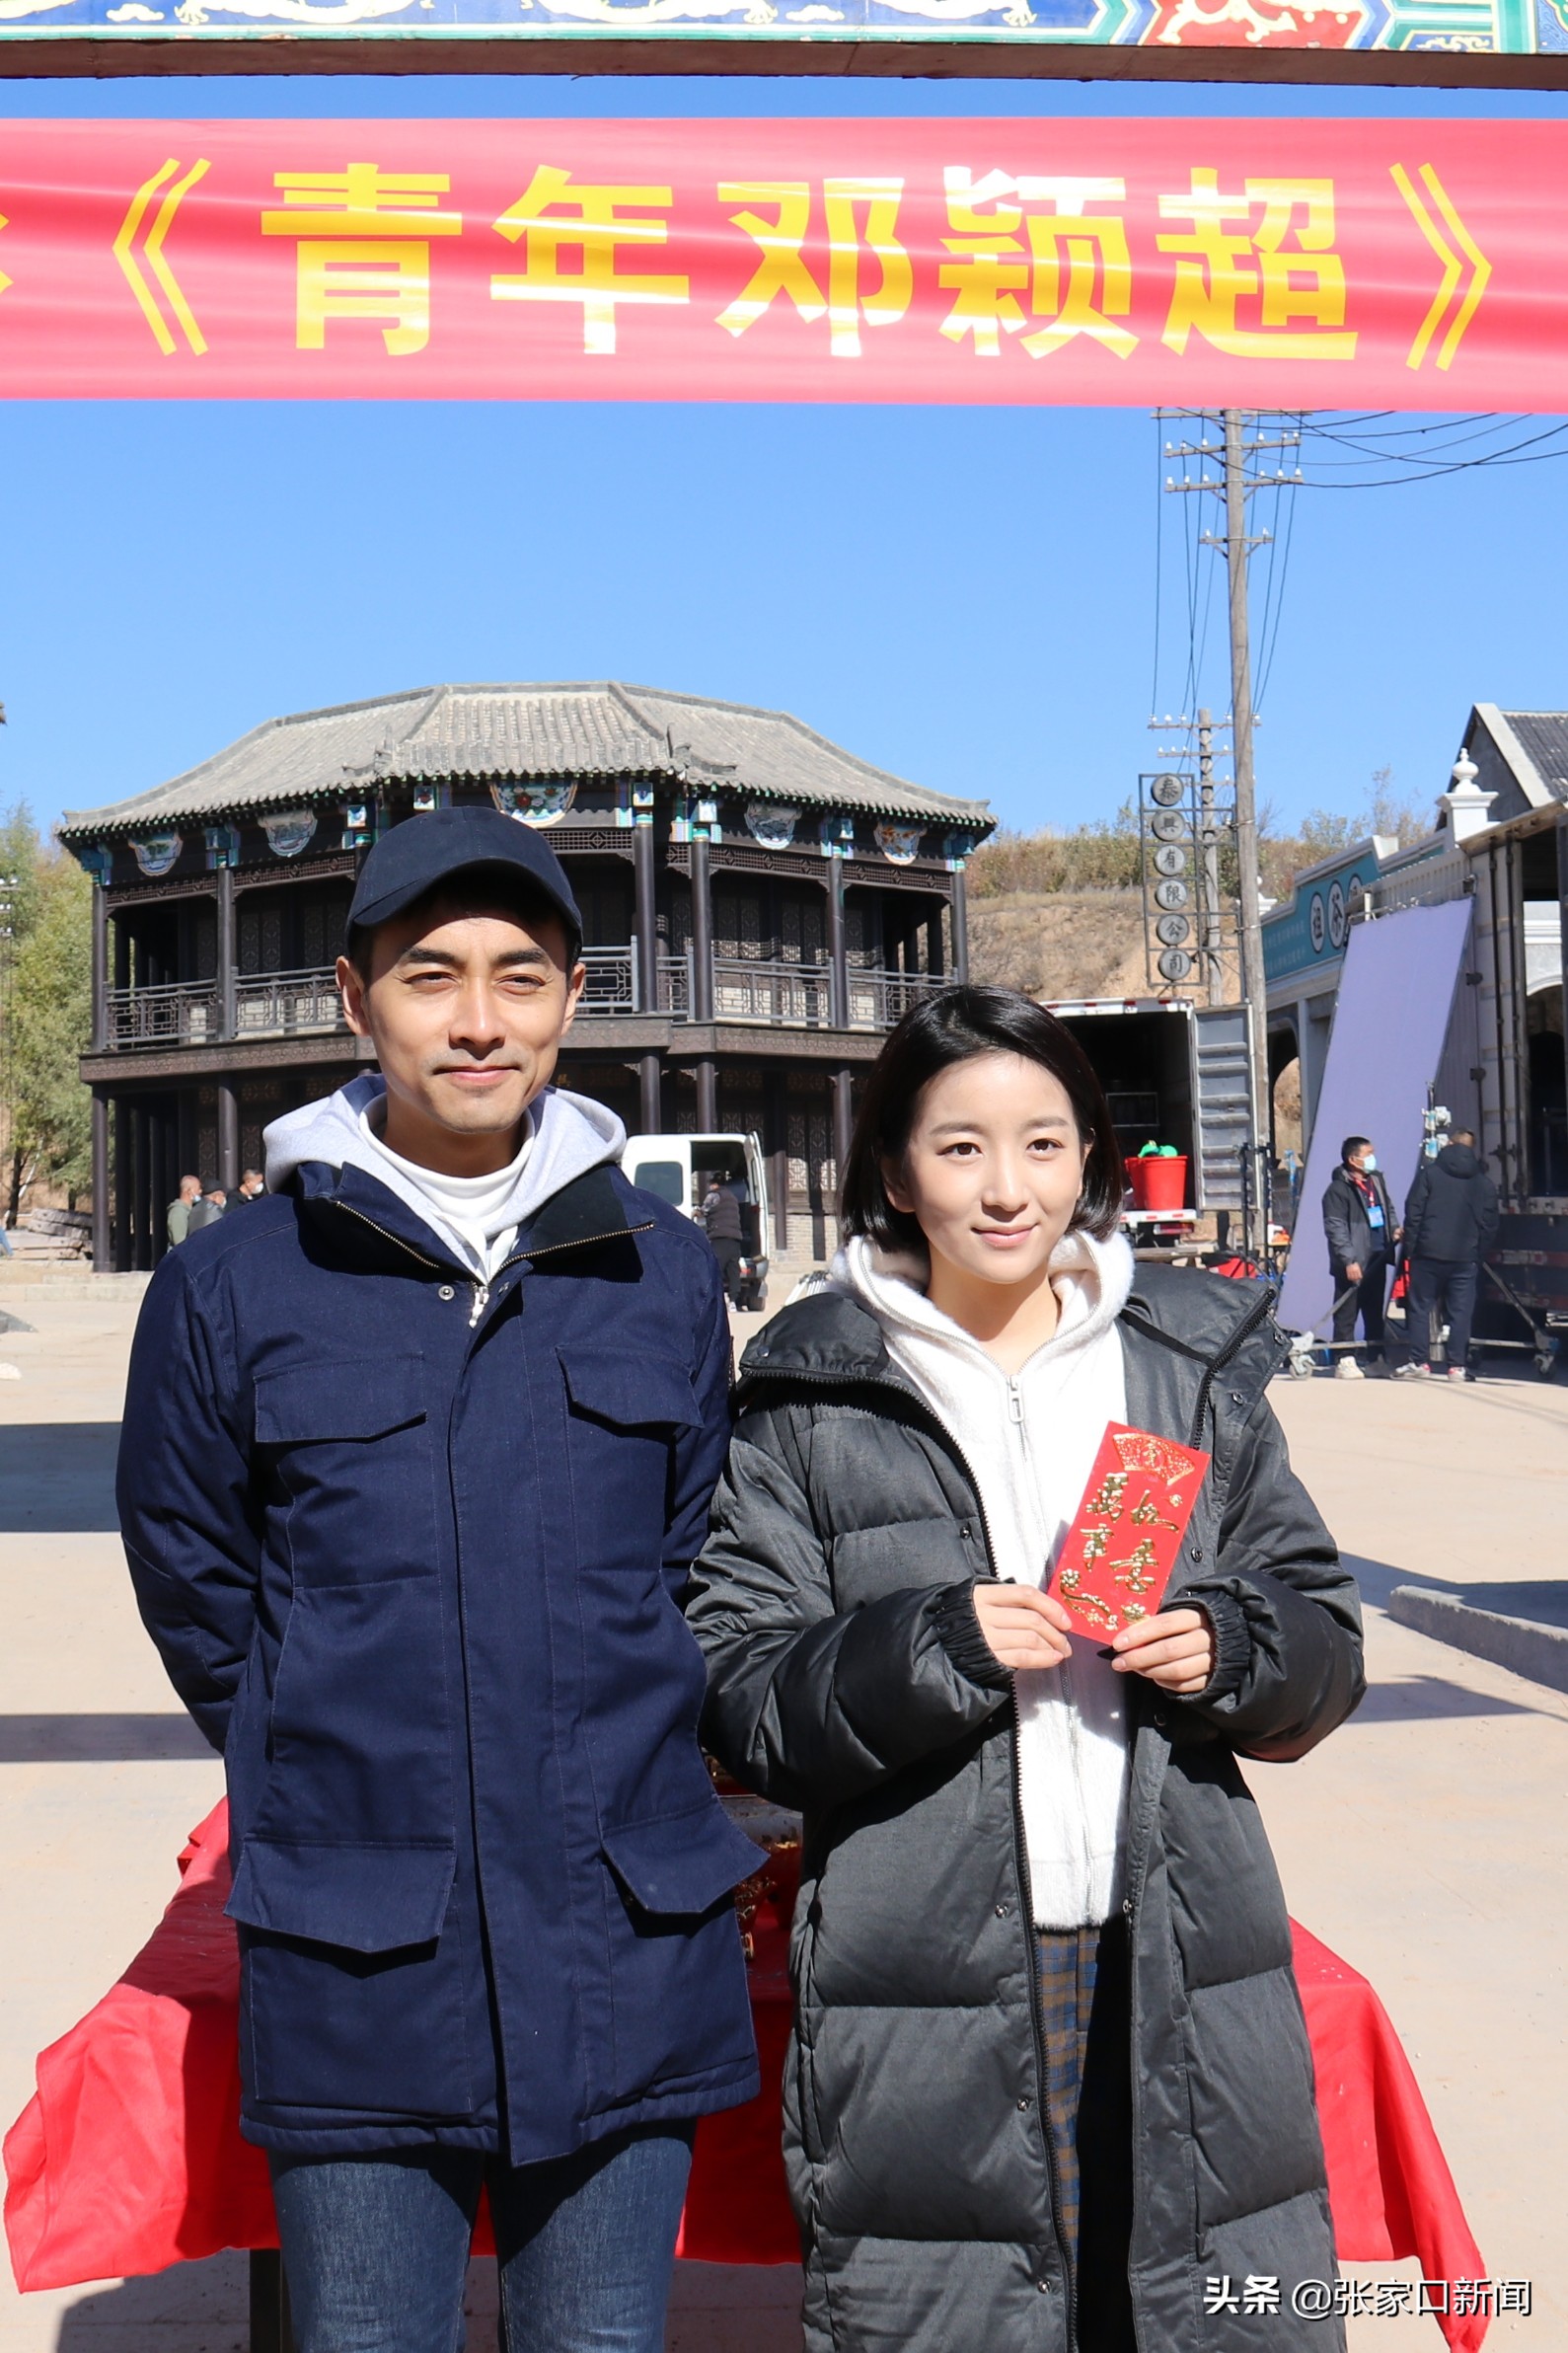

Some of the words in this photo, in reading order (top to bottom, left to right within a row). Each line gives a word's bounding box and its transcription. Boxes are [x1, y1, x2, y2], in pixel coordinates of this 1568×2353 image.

[0, 158, 1492, 371] 《青年邓颖超》
